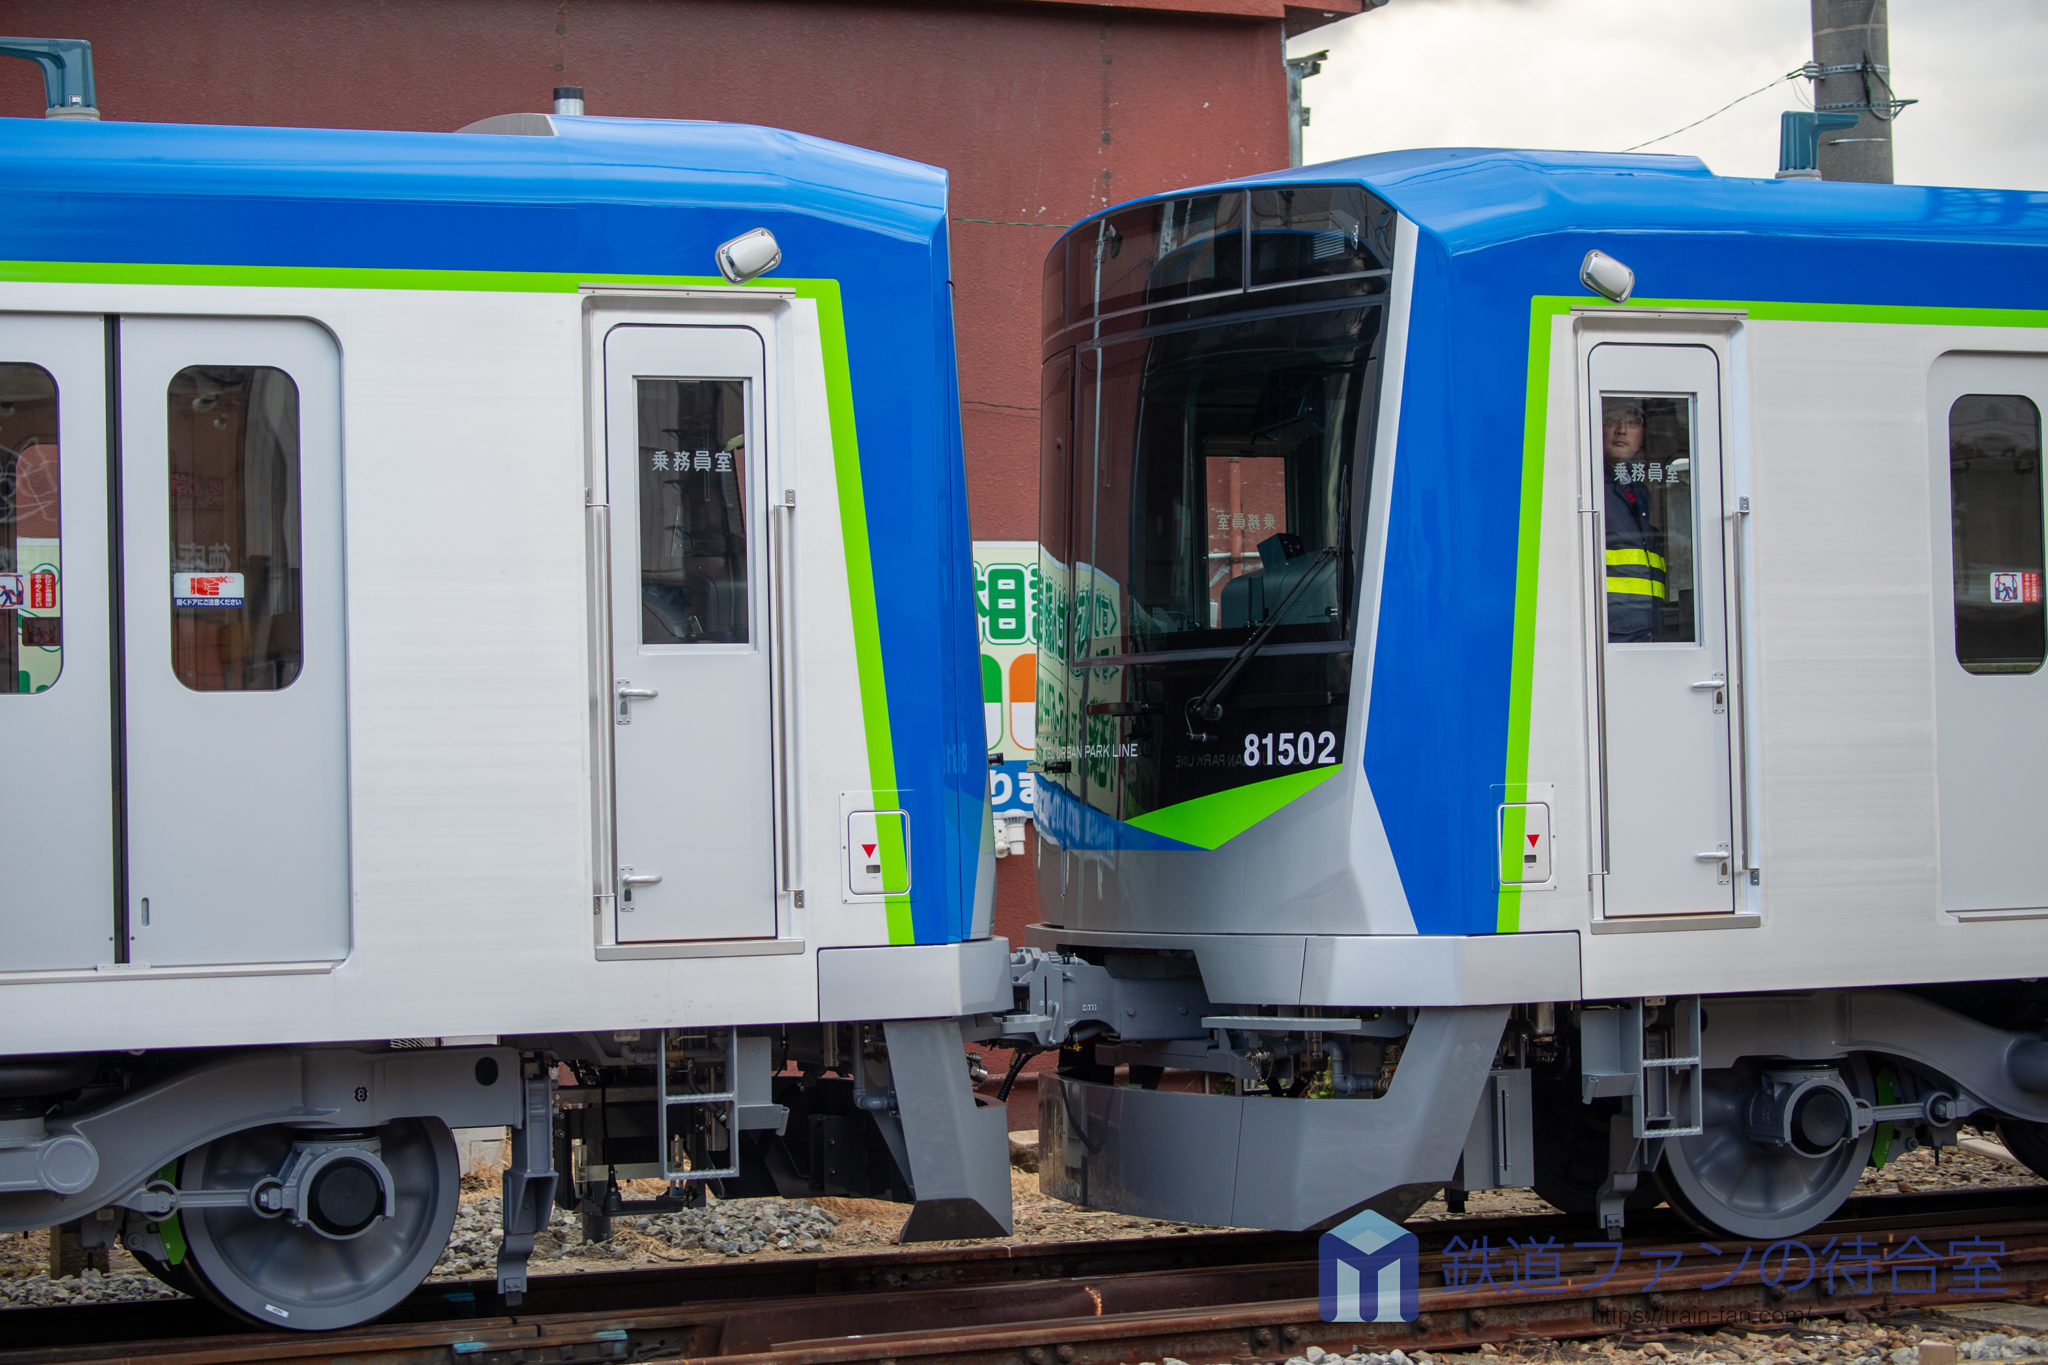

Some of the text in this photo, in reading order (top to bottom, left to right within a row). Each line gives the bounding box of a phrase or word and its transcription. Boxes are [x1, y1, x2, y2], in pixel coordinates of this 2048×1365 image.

[651, 450, 733, 473] 乗務員室
[1613, 462, 1680, 483] 乗務員室
[1084, 744, 1110, 759] PARK
[1113, 743, 1139, 758] LINE
[1243, 730, 1337, 767] 81502
